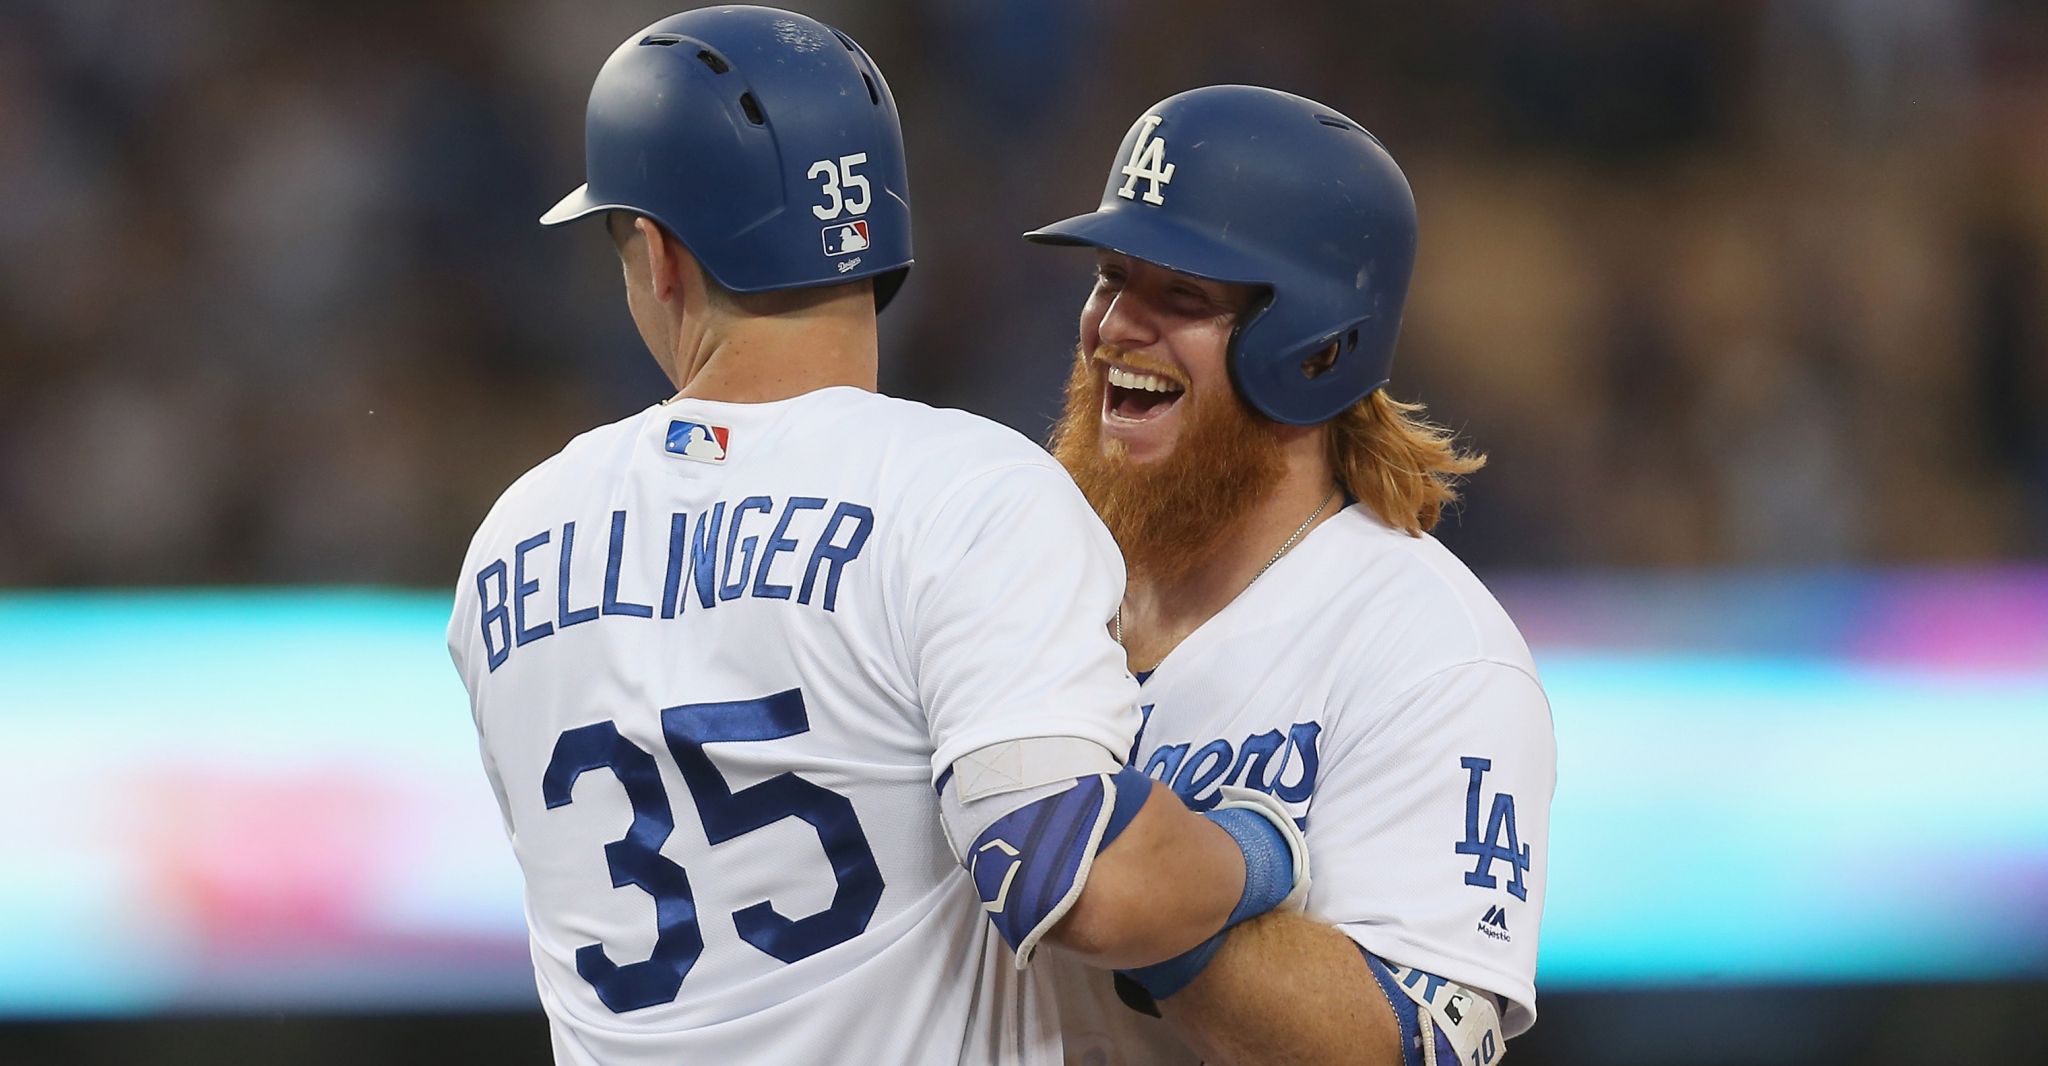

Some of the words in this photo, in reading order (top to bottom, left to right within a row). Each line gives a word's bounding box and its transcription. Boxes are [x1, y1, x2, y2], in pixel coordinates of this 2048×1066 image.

[807, 152, 872, 220] 35
[1118, 115, 1175, 206] LA
[476, 496, 874, 672] BELLINGER
[542, 688, 886, 1014] 35
[1455, 756, 1530, 902] LA
[1477, 922, 1511, 943] Majestic
